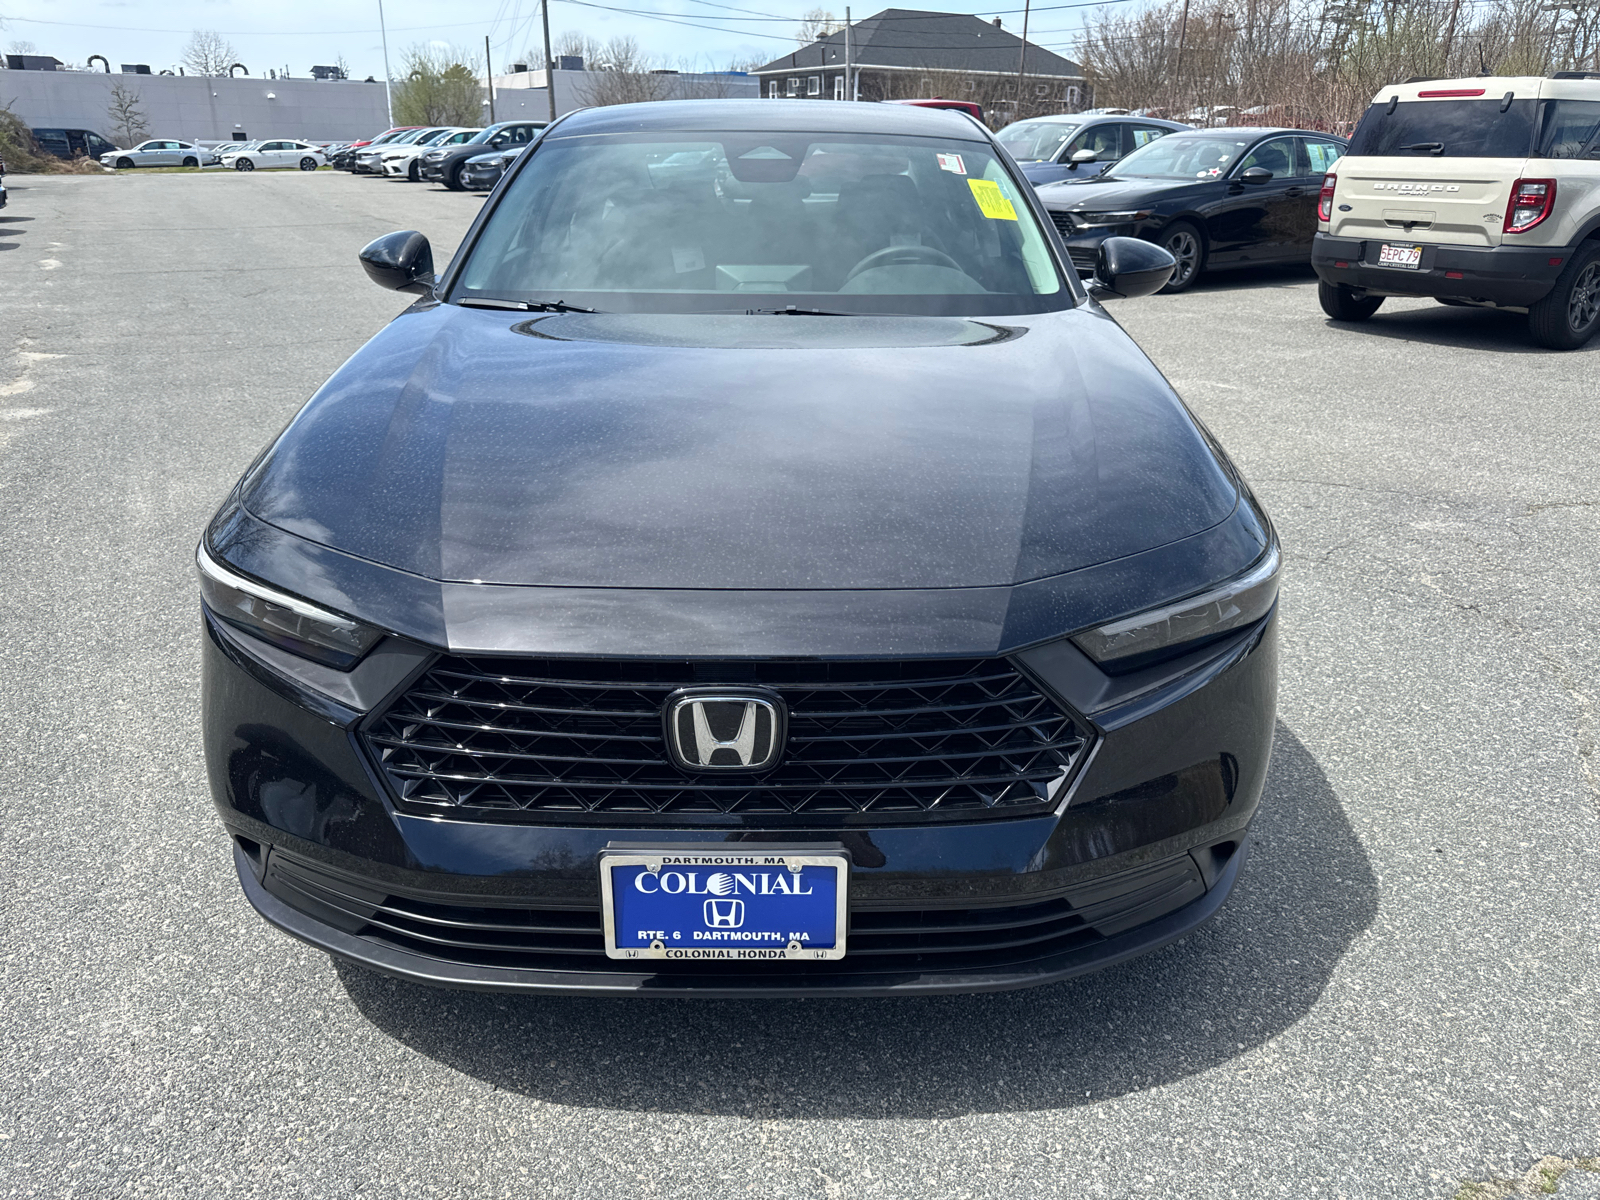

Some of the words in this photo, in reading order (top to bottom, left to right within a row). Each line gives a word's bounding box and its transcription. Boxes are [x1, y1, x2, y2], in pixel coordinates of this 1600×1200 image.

[1373, 183, 1460, 192] BRONCO
[1406, 250, 1420, 263] 79
[634, 871, 813, 896] COLONIAL
[637, 930, 669, 940] RTE.
[672, 931, 682, 940] 6
[693, 931, 785, 942] DARTMOUTH,
[789, 932, 810, 941] MA
[665, 949, 733, 958] COLONIAL
[737, 950, 787, 958] HONDA
